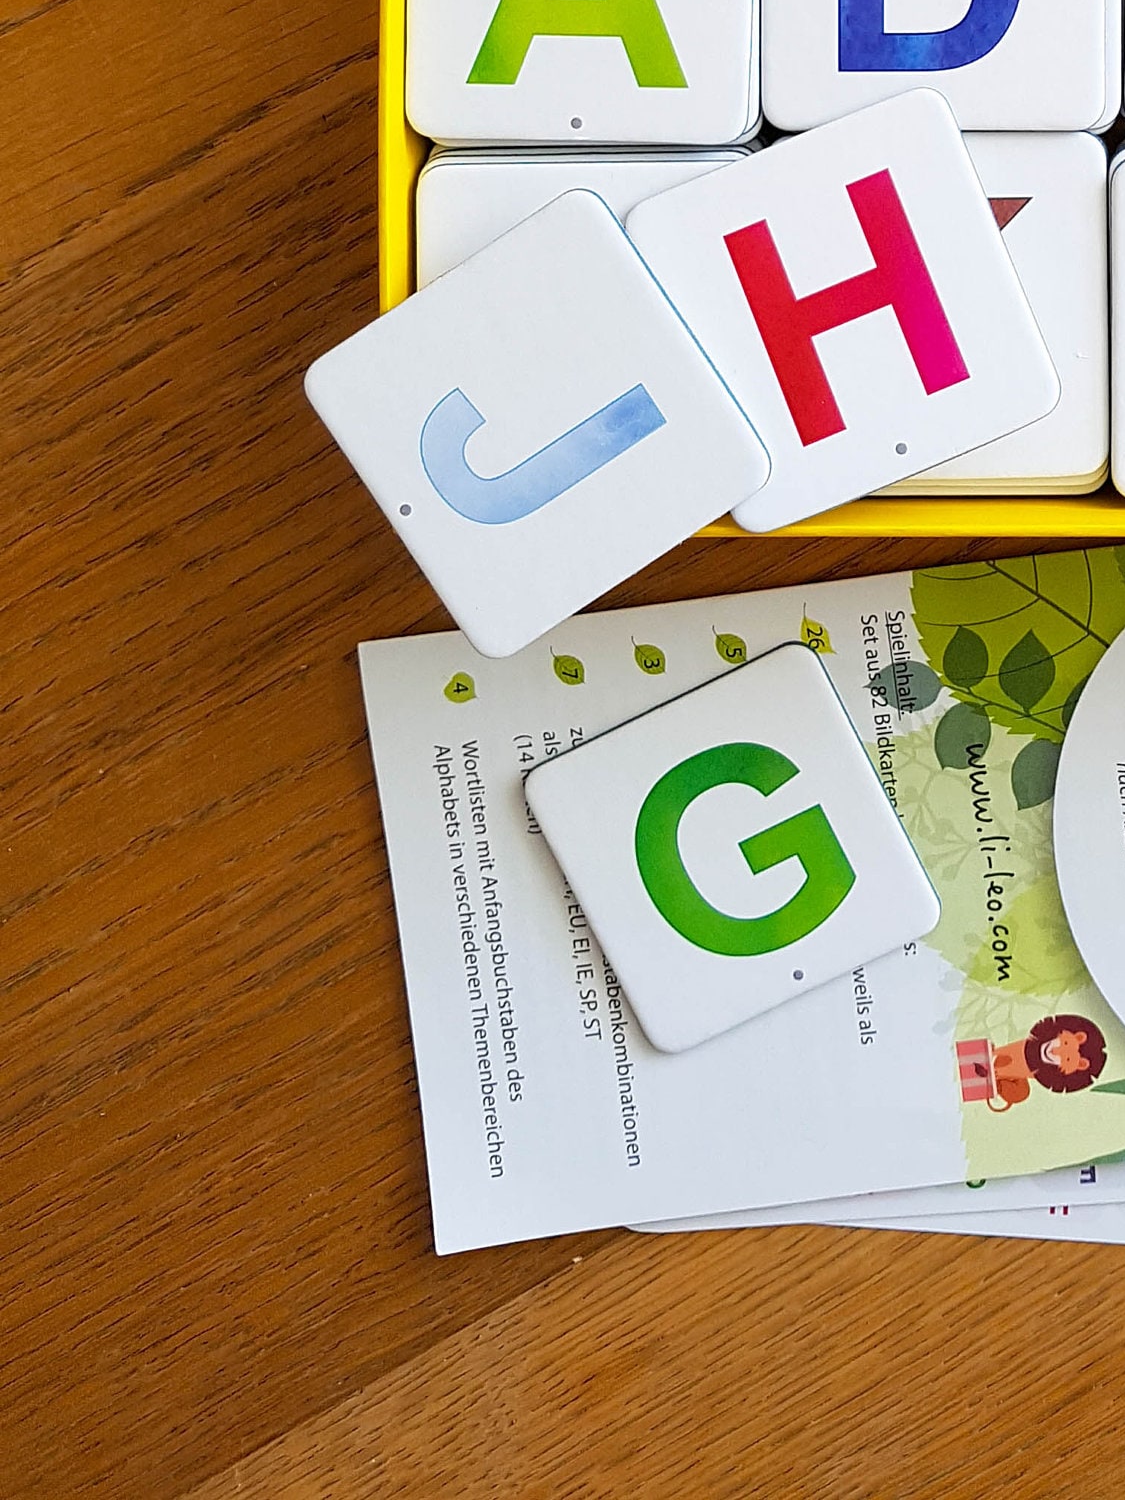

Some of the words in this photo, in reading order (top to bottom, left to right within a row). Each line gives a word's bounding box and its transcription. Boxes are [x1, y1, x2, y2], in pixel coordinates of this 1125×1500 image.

[723, 167, 970, 447] H
[419, 383, 666, 525] J
[807, 627, 825, 649] 26
[861, 614, 879, 645] Set
[644, 658, 660, 669] 3
[726, 647, 742, 658] 5
[866, 650, 881, 681] aus
[885, 610, 917, 715] Spielinhalt:
[453, 682, 468, 693] 4
[562, 668, 578, 679] 7
[871, 684, 888, 708] 82
[543, 731, 563, 755] als
[433, 744, 461, 838] Alphabets
[461, 740, 487, 835] Wortlisten
[449, 841, 464, 860] in
[476, 840, 493, 871] mit
[635, 741, 856, 957] G
[965, 743, 1015, 982] www.li-leo.com
[452, 865, 482, 1000] verschiedenen
[482, 877, 519, 1064] Anfangsbuchstaben
[579, 989, 598, 1014] SP,
[584, 1016, 602, 1040] ST
[859, 1020, 877, 1045] als
[471, 1004, 505, 1178] Themenbereichen
[507, 1068, 525, 1102] des
